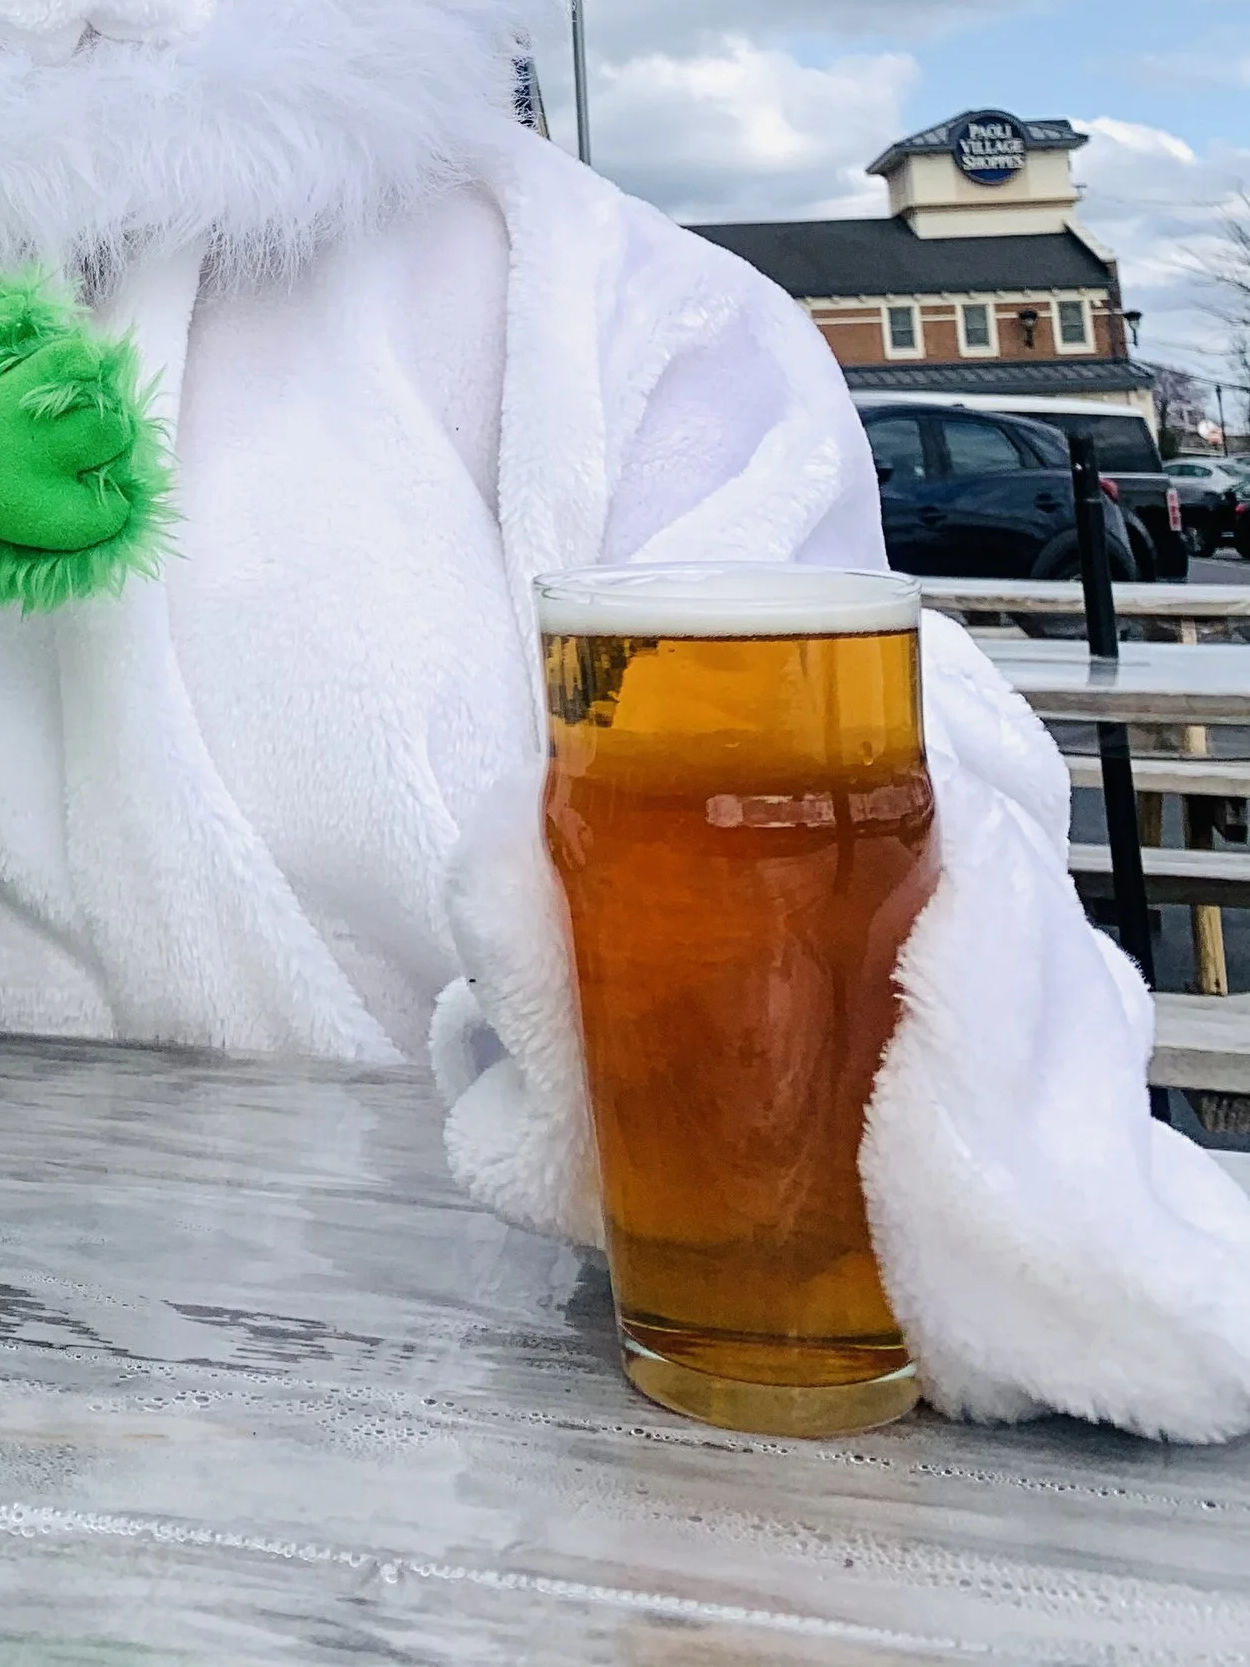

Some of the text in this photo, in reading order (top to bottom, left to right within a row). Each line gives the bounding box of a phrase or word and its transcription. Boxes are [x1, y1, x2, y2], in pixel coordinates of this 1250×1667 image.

[968, 123, 1013, 140] PAOLI
[959, 138, 1024, 155] VILLAGE
[962, 154, 1025, 170] SHOPPES
